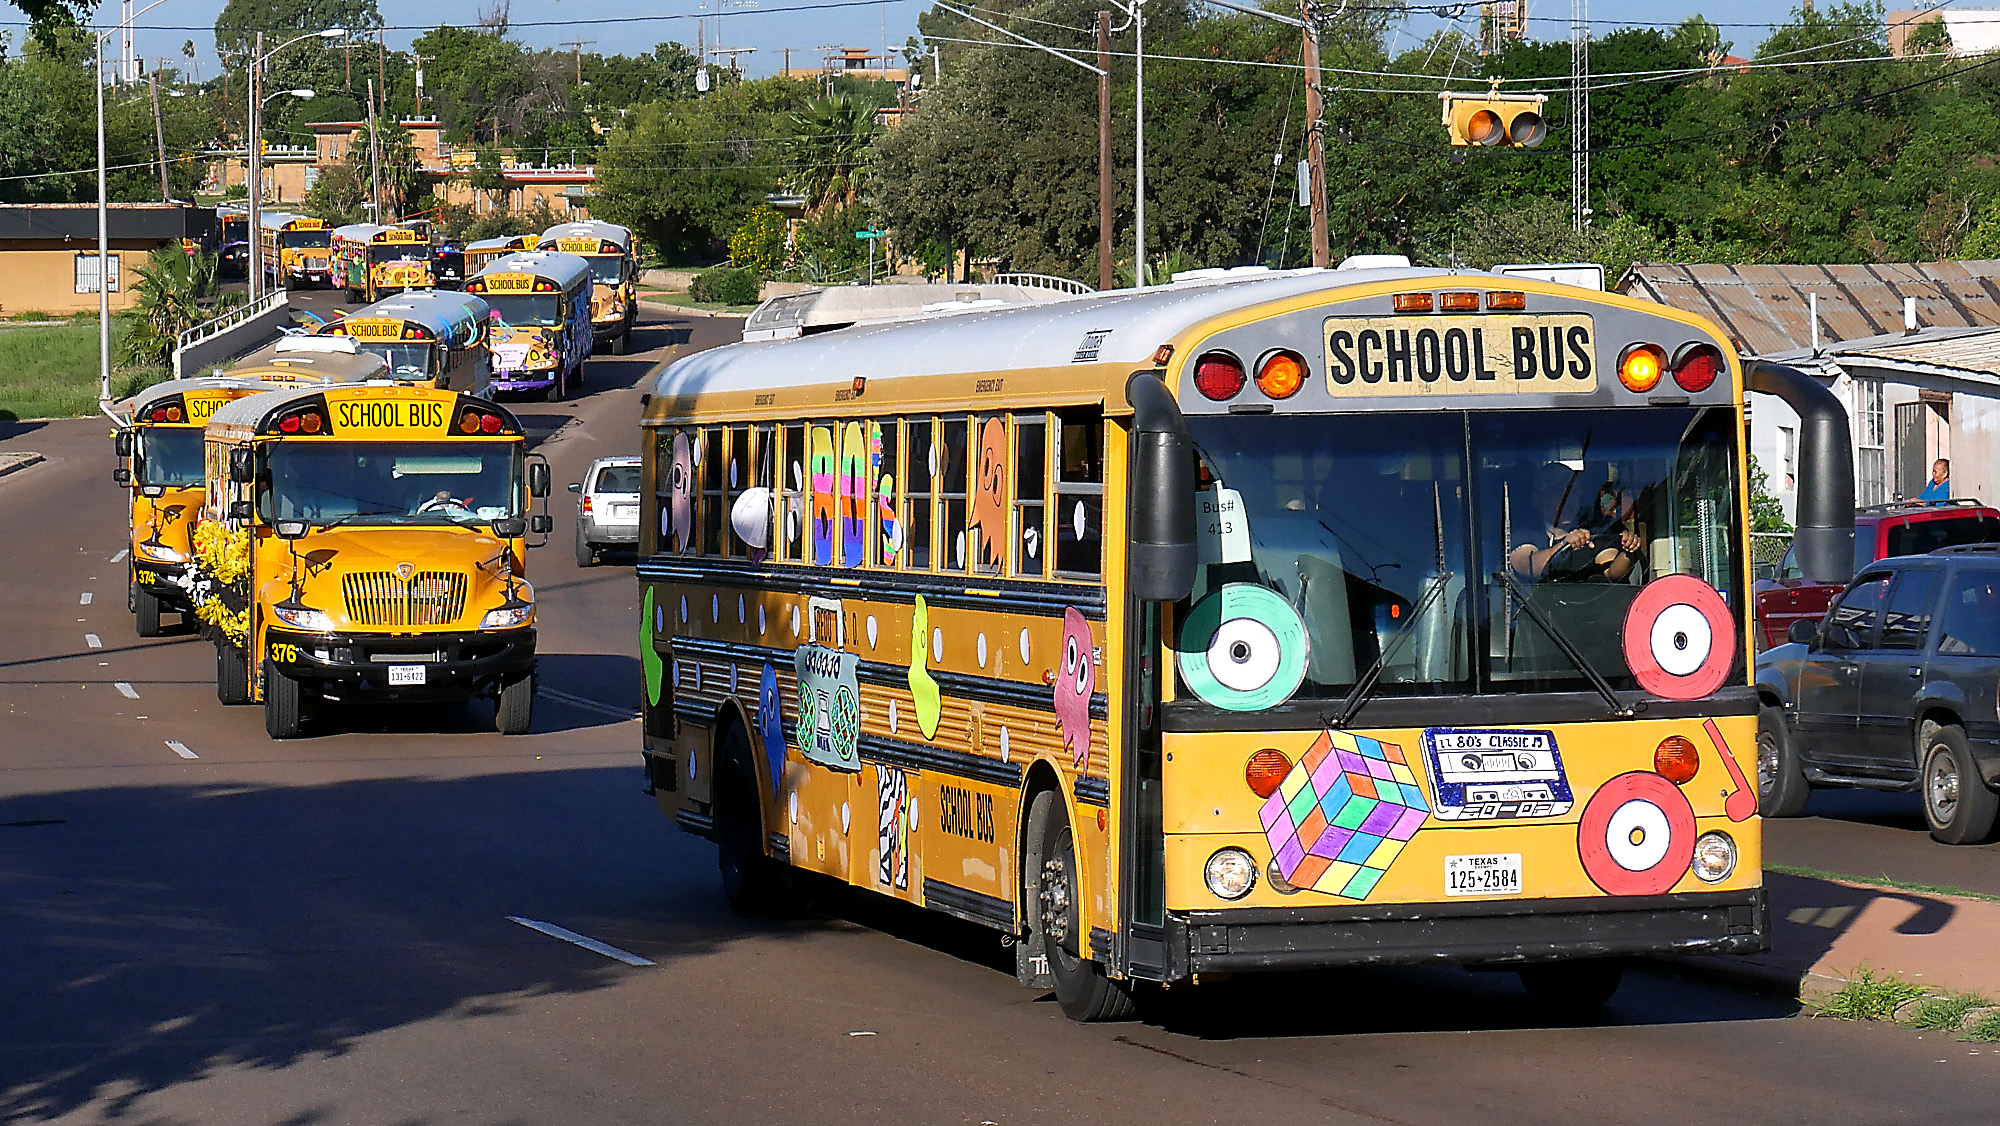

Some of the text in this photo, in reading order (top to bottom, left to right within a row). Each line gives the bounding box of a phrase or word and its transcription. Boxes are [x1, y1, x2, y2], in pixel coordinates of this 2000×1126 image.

[561, 242, 597, 251] SCHOOL BUS
[489, 279, 529, 290] SCHOOL BUS
[351, 325, 398, 337] SCHOOL BUS
[1329, 326, 1592, 385] SCHOOL BUS
[193, 400, 231, 417] SCHO
[339, 402, 443, 428] SCHOOL BUS
[1203, 499, 1235, 514] Bus#
[1208, 522, 1233, 535] 413
[138, 569, 156, 585] 374
[271, 642, 297, 663] 376
[1456, 735, 1529, 748] 80's CLASSIC
[940, 784, 995, 844] SCHOOL BUS
[1468, 857, 1498, 866] TEXAS
